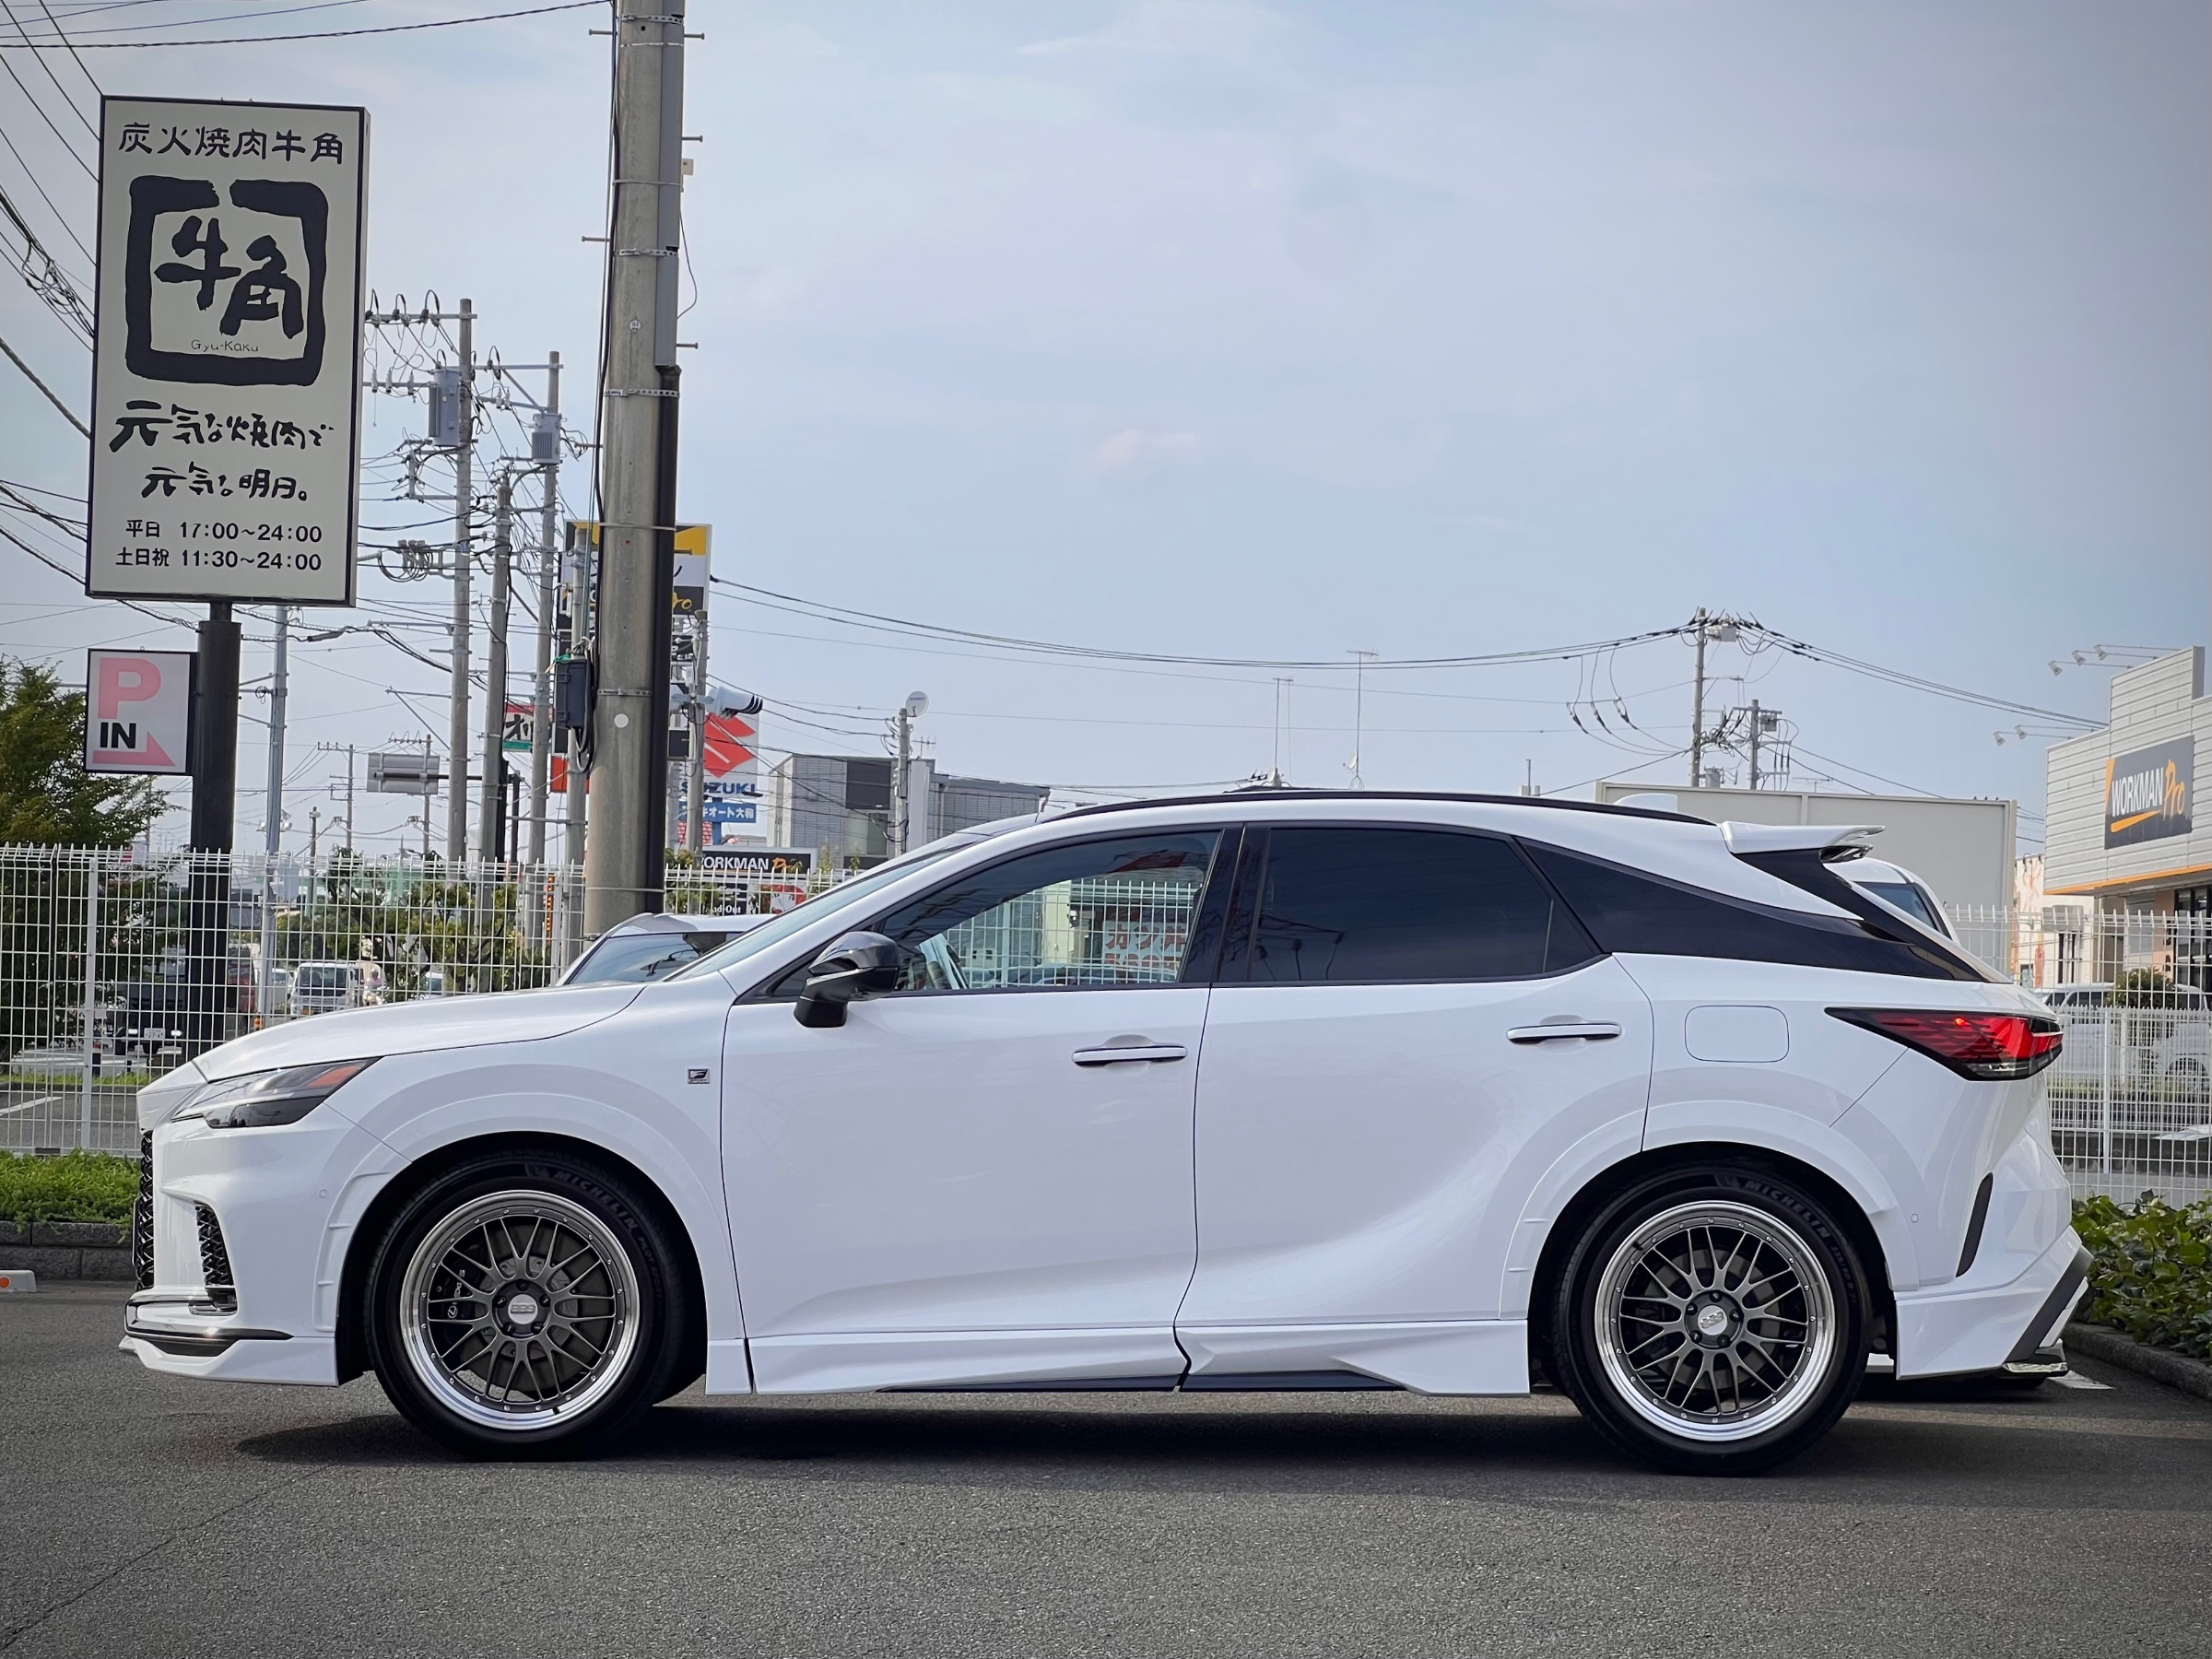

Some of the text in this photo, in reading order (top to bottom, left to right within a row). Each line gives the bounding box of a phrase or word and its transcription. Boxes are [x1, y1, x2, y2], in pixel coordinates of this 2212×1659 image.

[118, 122, 343, 165] 炭火焼肉牛角
[154, 215, 304, 339] 牛角
[109, 399, 334, 453] 元気な焼肉で
[125, 519, 160, 538] 平日
[115, 547, 170, 567] 土日祝
[98, 657, 161, 719] P
[100, 722, 136, 749] IN
[2112, 759, 2185, 821] WORKMAN Pro
[701, 856, 769, 871] ORKMAN
[554, 1170, 638, 1230] MICHELIN
[1745, 1180, 1830, 1239] MICHELIN
